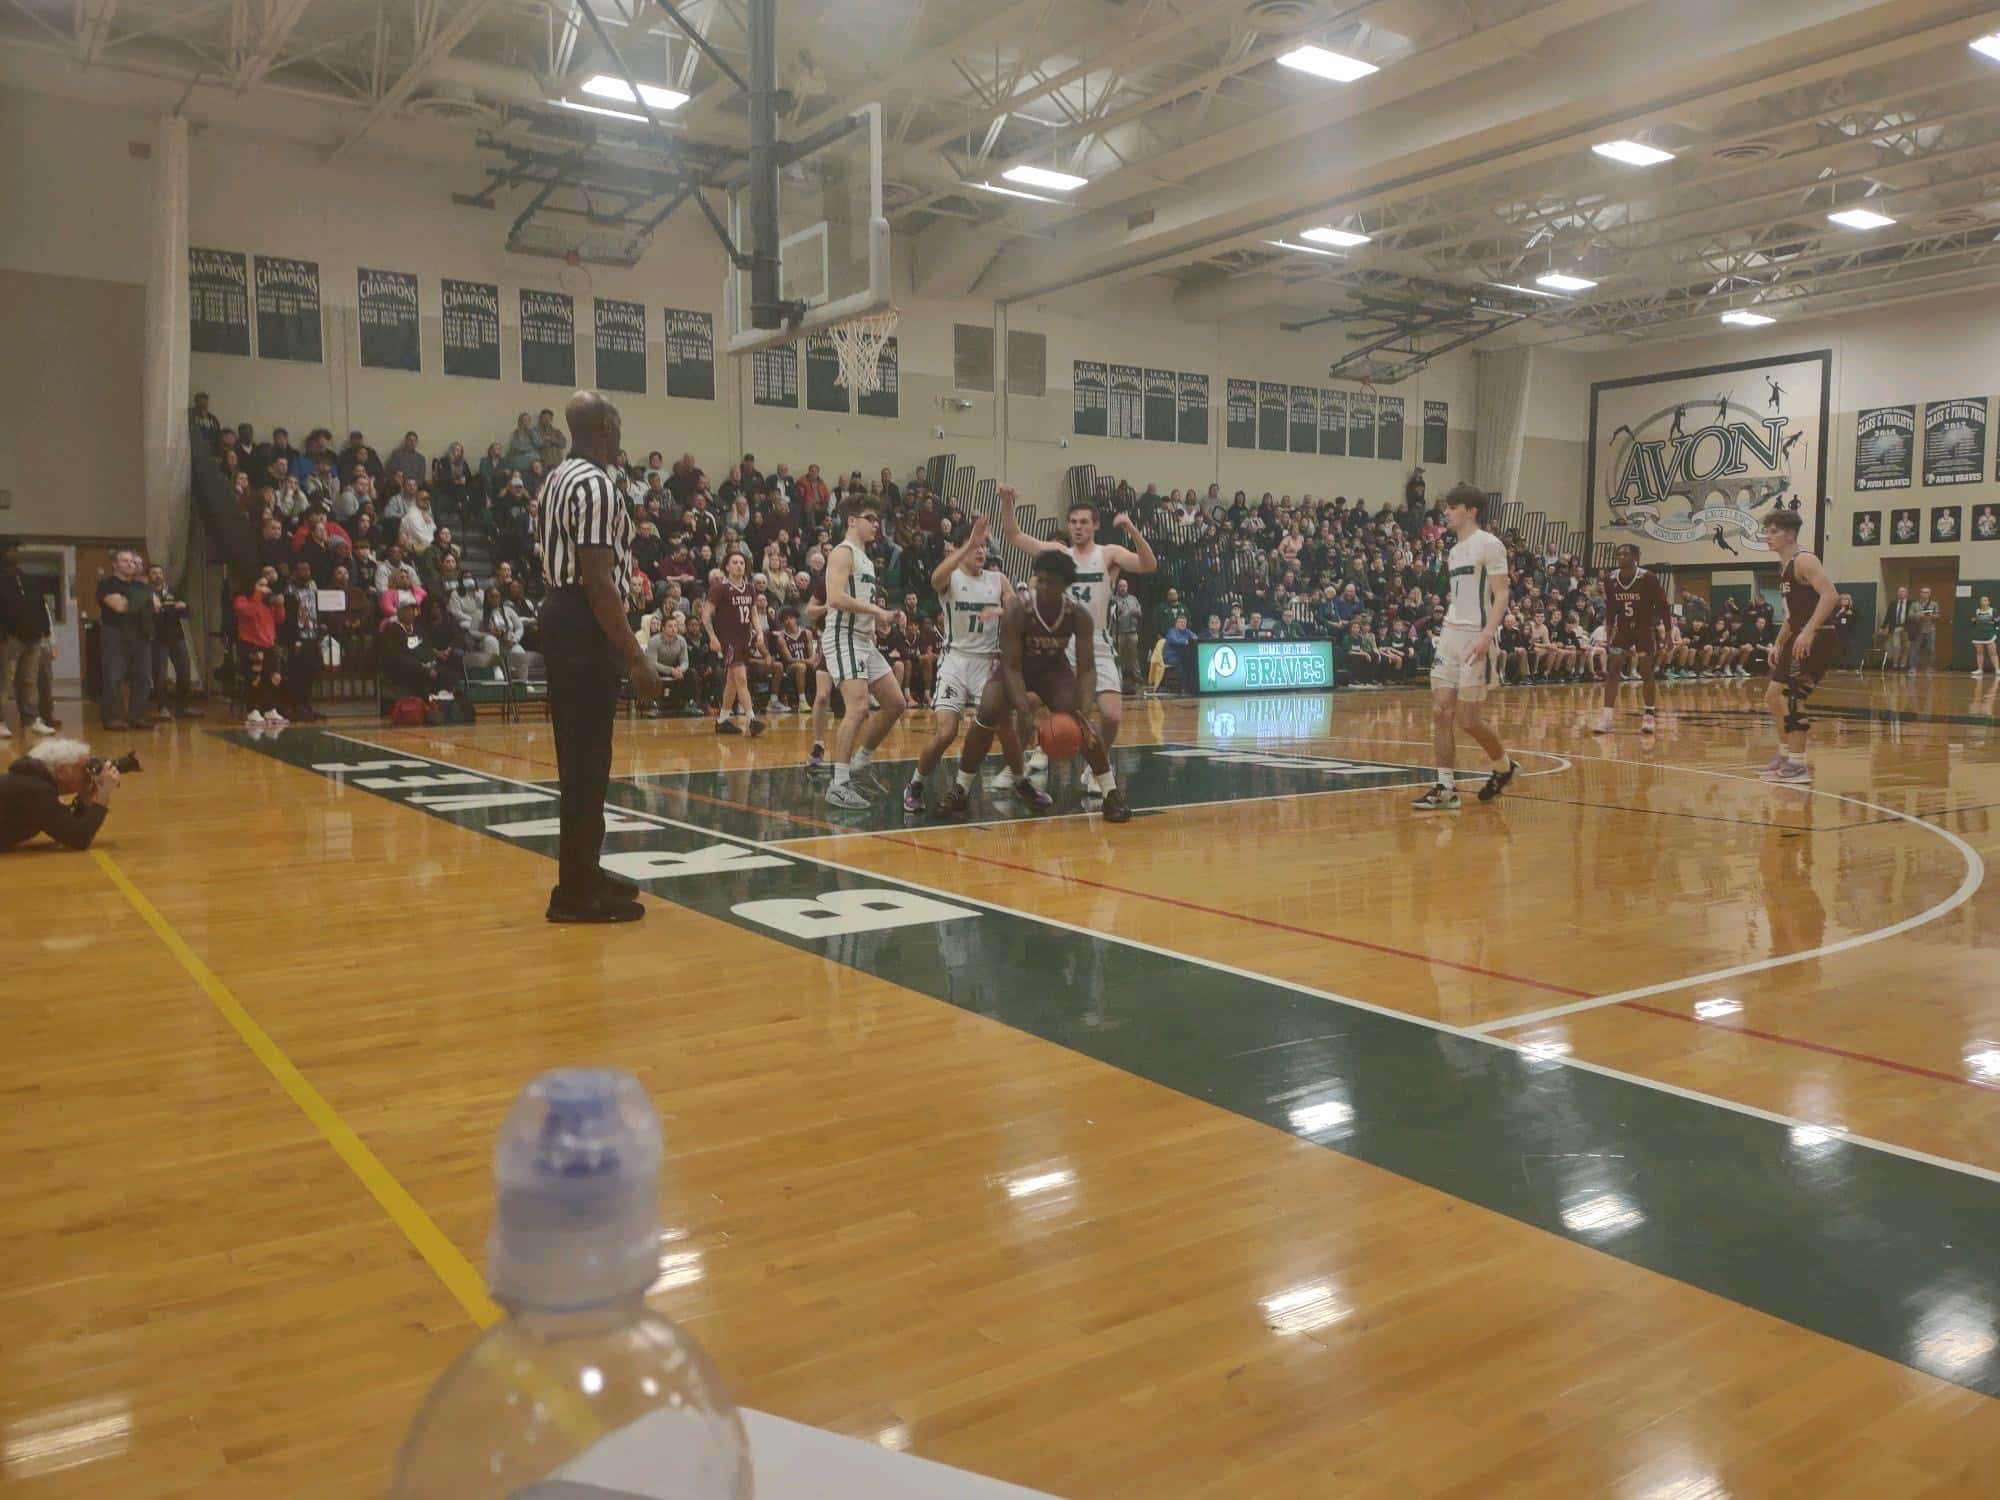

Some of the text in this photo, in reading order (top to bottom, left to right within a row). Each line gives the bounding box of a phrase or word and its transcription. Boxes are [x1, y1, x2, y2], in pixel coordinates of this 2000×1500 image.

[191, 262, 246, 286] AMPIONS
[256, 267, 318, 295] CHAMPIONS
[359, 279, 417, 306] CHAMPIONS
[443, 290, 497, 315] CHAMPIONS
[522, 300, 573, 324] CHAMPIONS
[596, 309, 644, 333] CHAMPIONS
[666, 319, 712, 341] CHAMPIONS
[1609, 416, 1789, 506] AVON
[1071, 585, 1092, 604] 54
[1615, 592, 1641, 601] LYONS
[738, 605, 750, 624] 12
[1624, 601, 1635, 617] 5
[1220, 652, 1232, 670] A
[1258, 643, 1281, 656] HOME
[1296, 642, 1312, 655] THE
[1244, 655, 1326, 688] BRAVES
